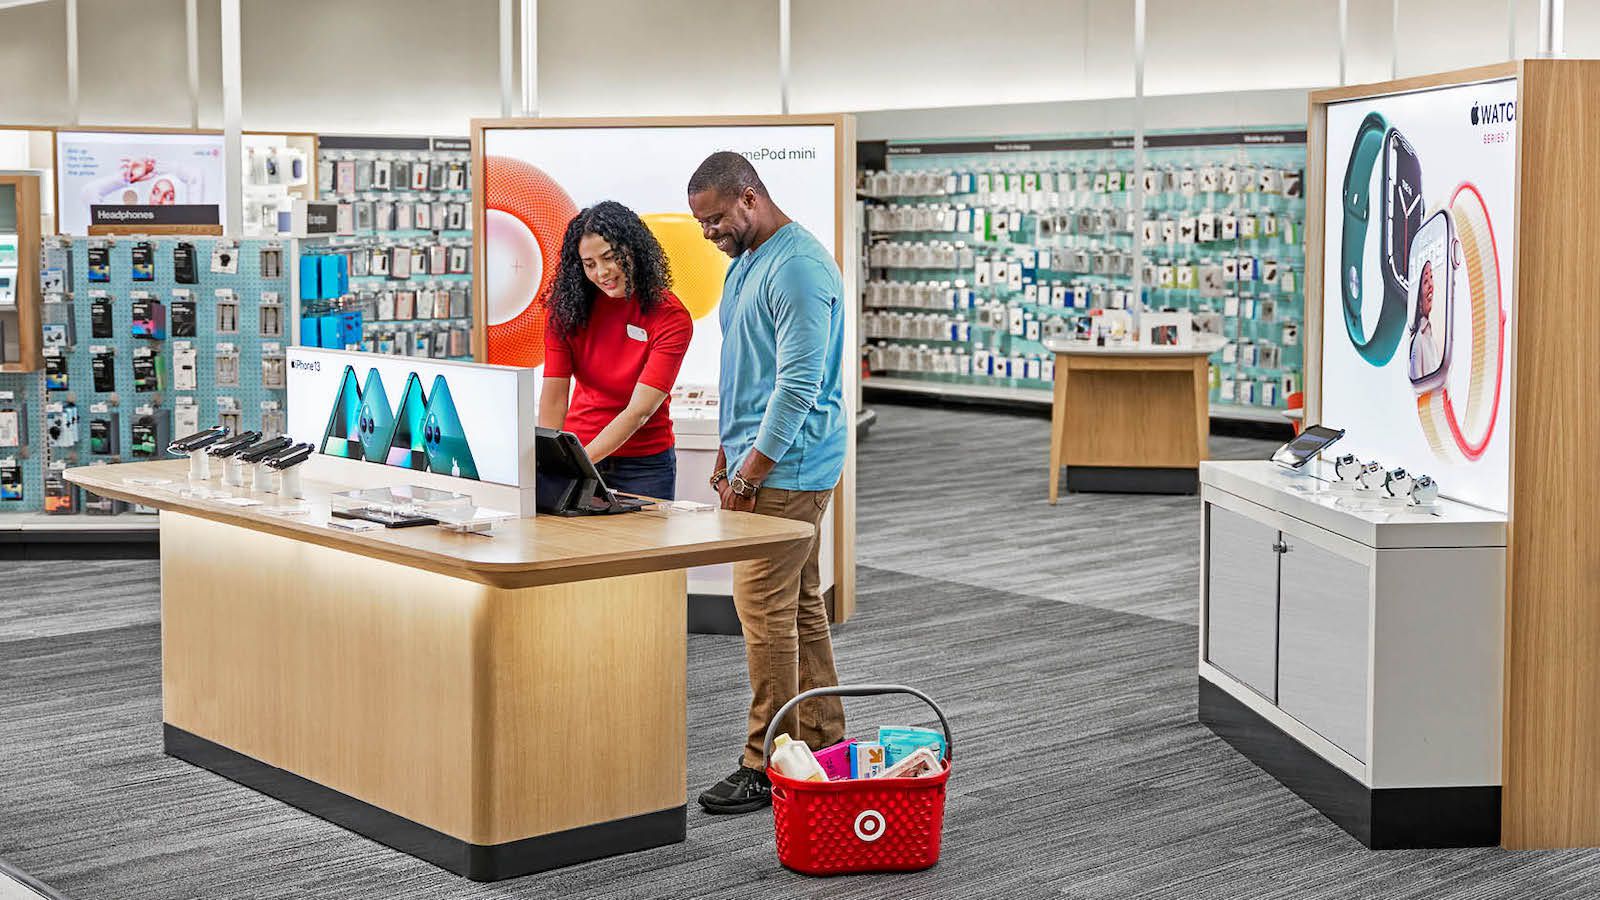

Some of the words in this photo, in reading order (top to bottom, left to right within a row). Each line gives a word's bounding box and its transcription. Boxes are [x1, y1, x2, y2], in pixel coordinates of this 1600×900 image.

[789, 147, 816, 159] mini
[97, 210, 154, 221] Headphones
[295, 359, 314, 371] iPhone
